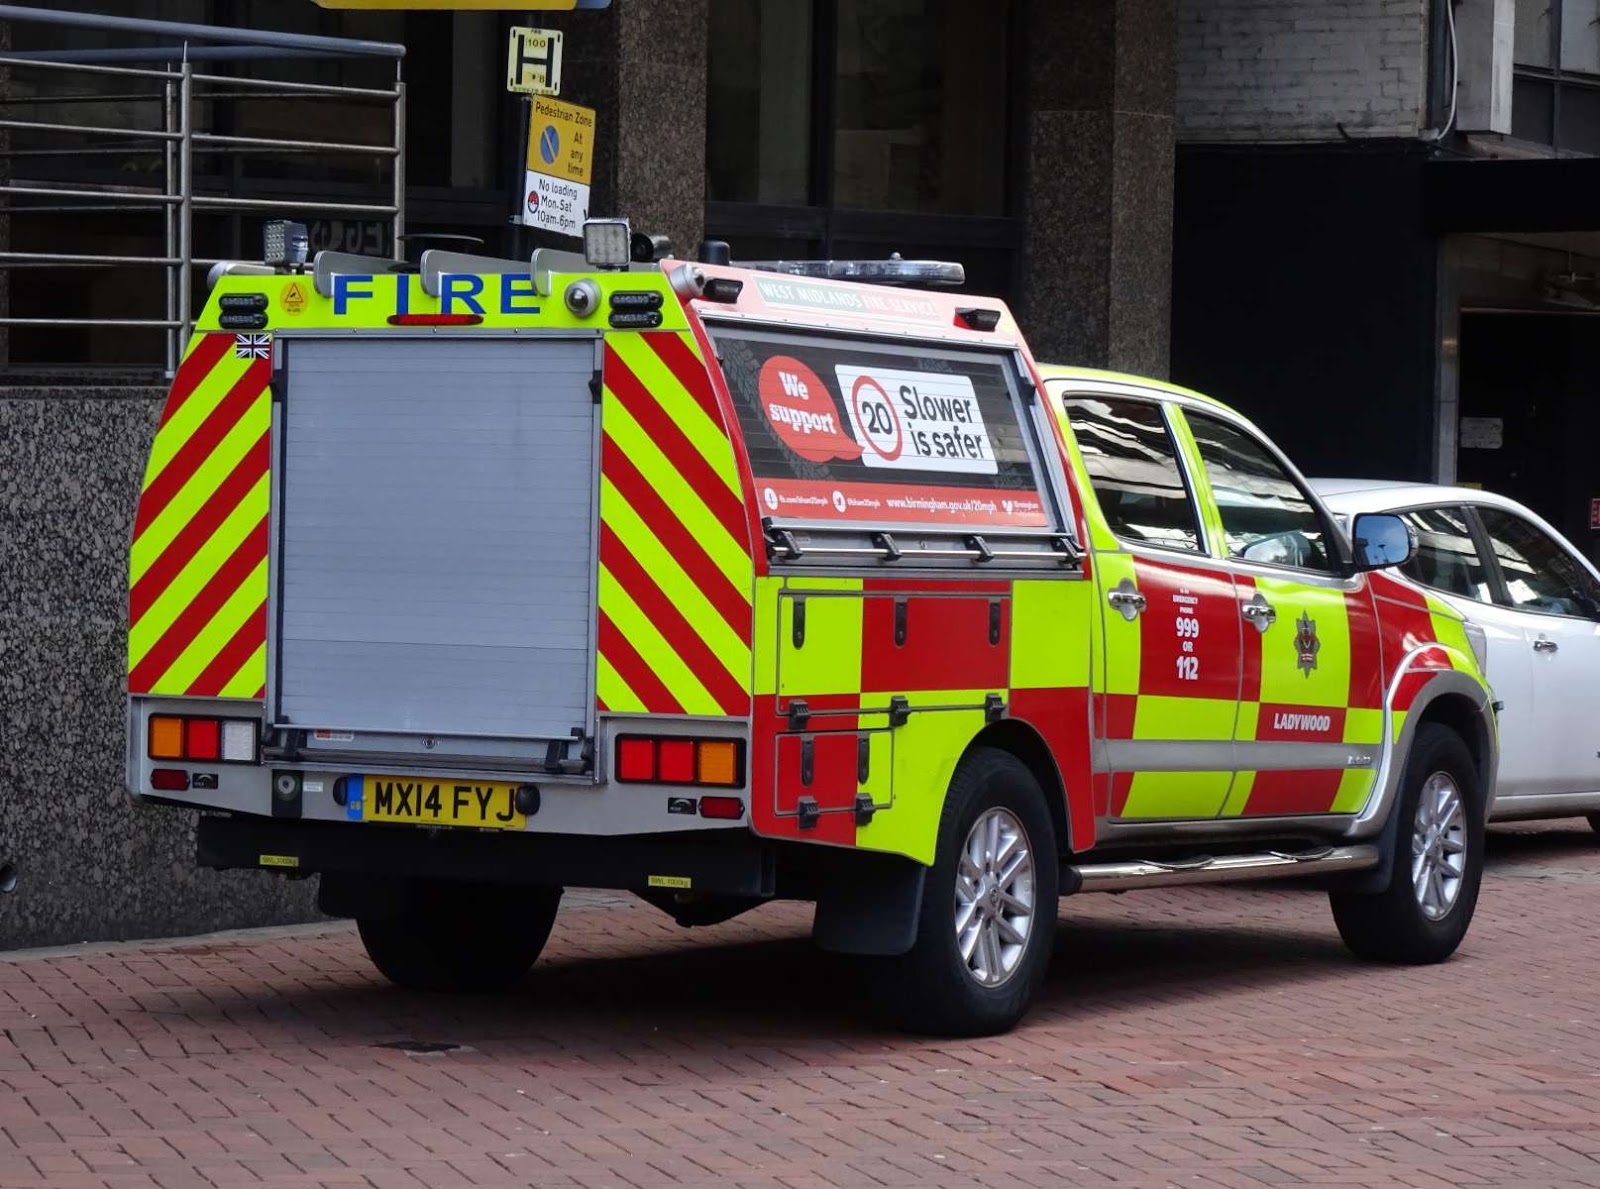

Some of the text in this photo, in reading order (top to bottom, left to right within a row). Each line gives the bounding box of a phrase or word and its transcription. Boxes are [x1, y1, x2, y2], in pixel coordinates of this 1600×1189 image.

[528, 38, 546, 48] 100
[535, 101, 592, 128] Pedestrian Zone
[574, 131, 583, 145] At
[568, 162, 583, 177] time
[570, 150, 583, 164] any
[539, 178, 578, 200] No loading
[334, 273, 542, 316] FIRE
[759, 282, 793, 299] WEST
[797, 287, 863, 308] MIDLANDS
[778, 372, 809, 400] We
[900, 385, 973, 423] Slower
[769, 403, 836, 434] support
[862, 401, 892, 435] 20
[908, 422, 984, 459] is safer
[1176, 617, 1199, 638] 999
[1176, 656, 1199, 680] 112
[1274, 713, 1331, 731] LADYWOOD
[375, 782, 515, 822] MX14 FYJ
